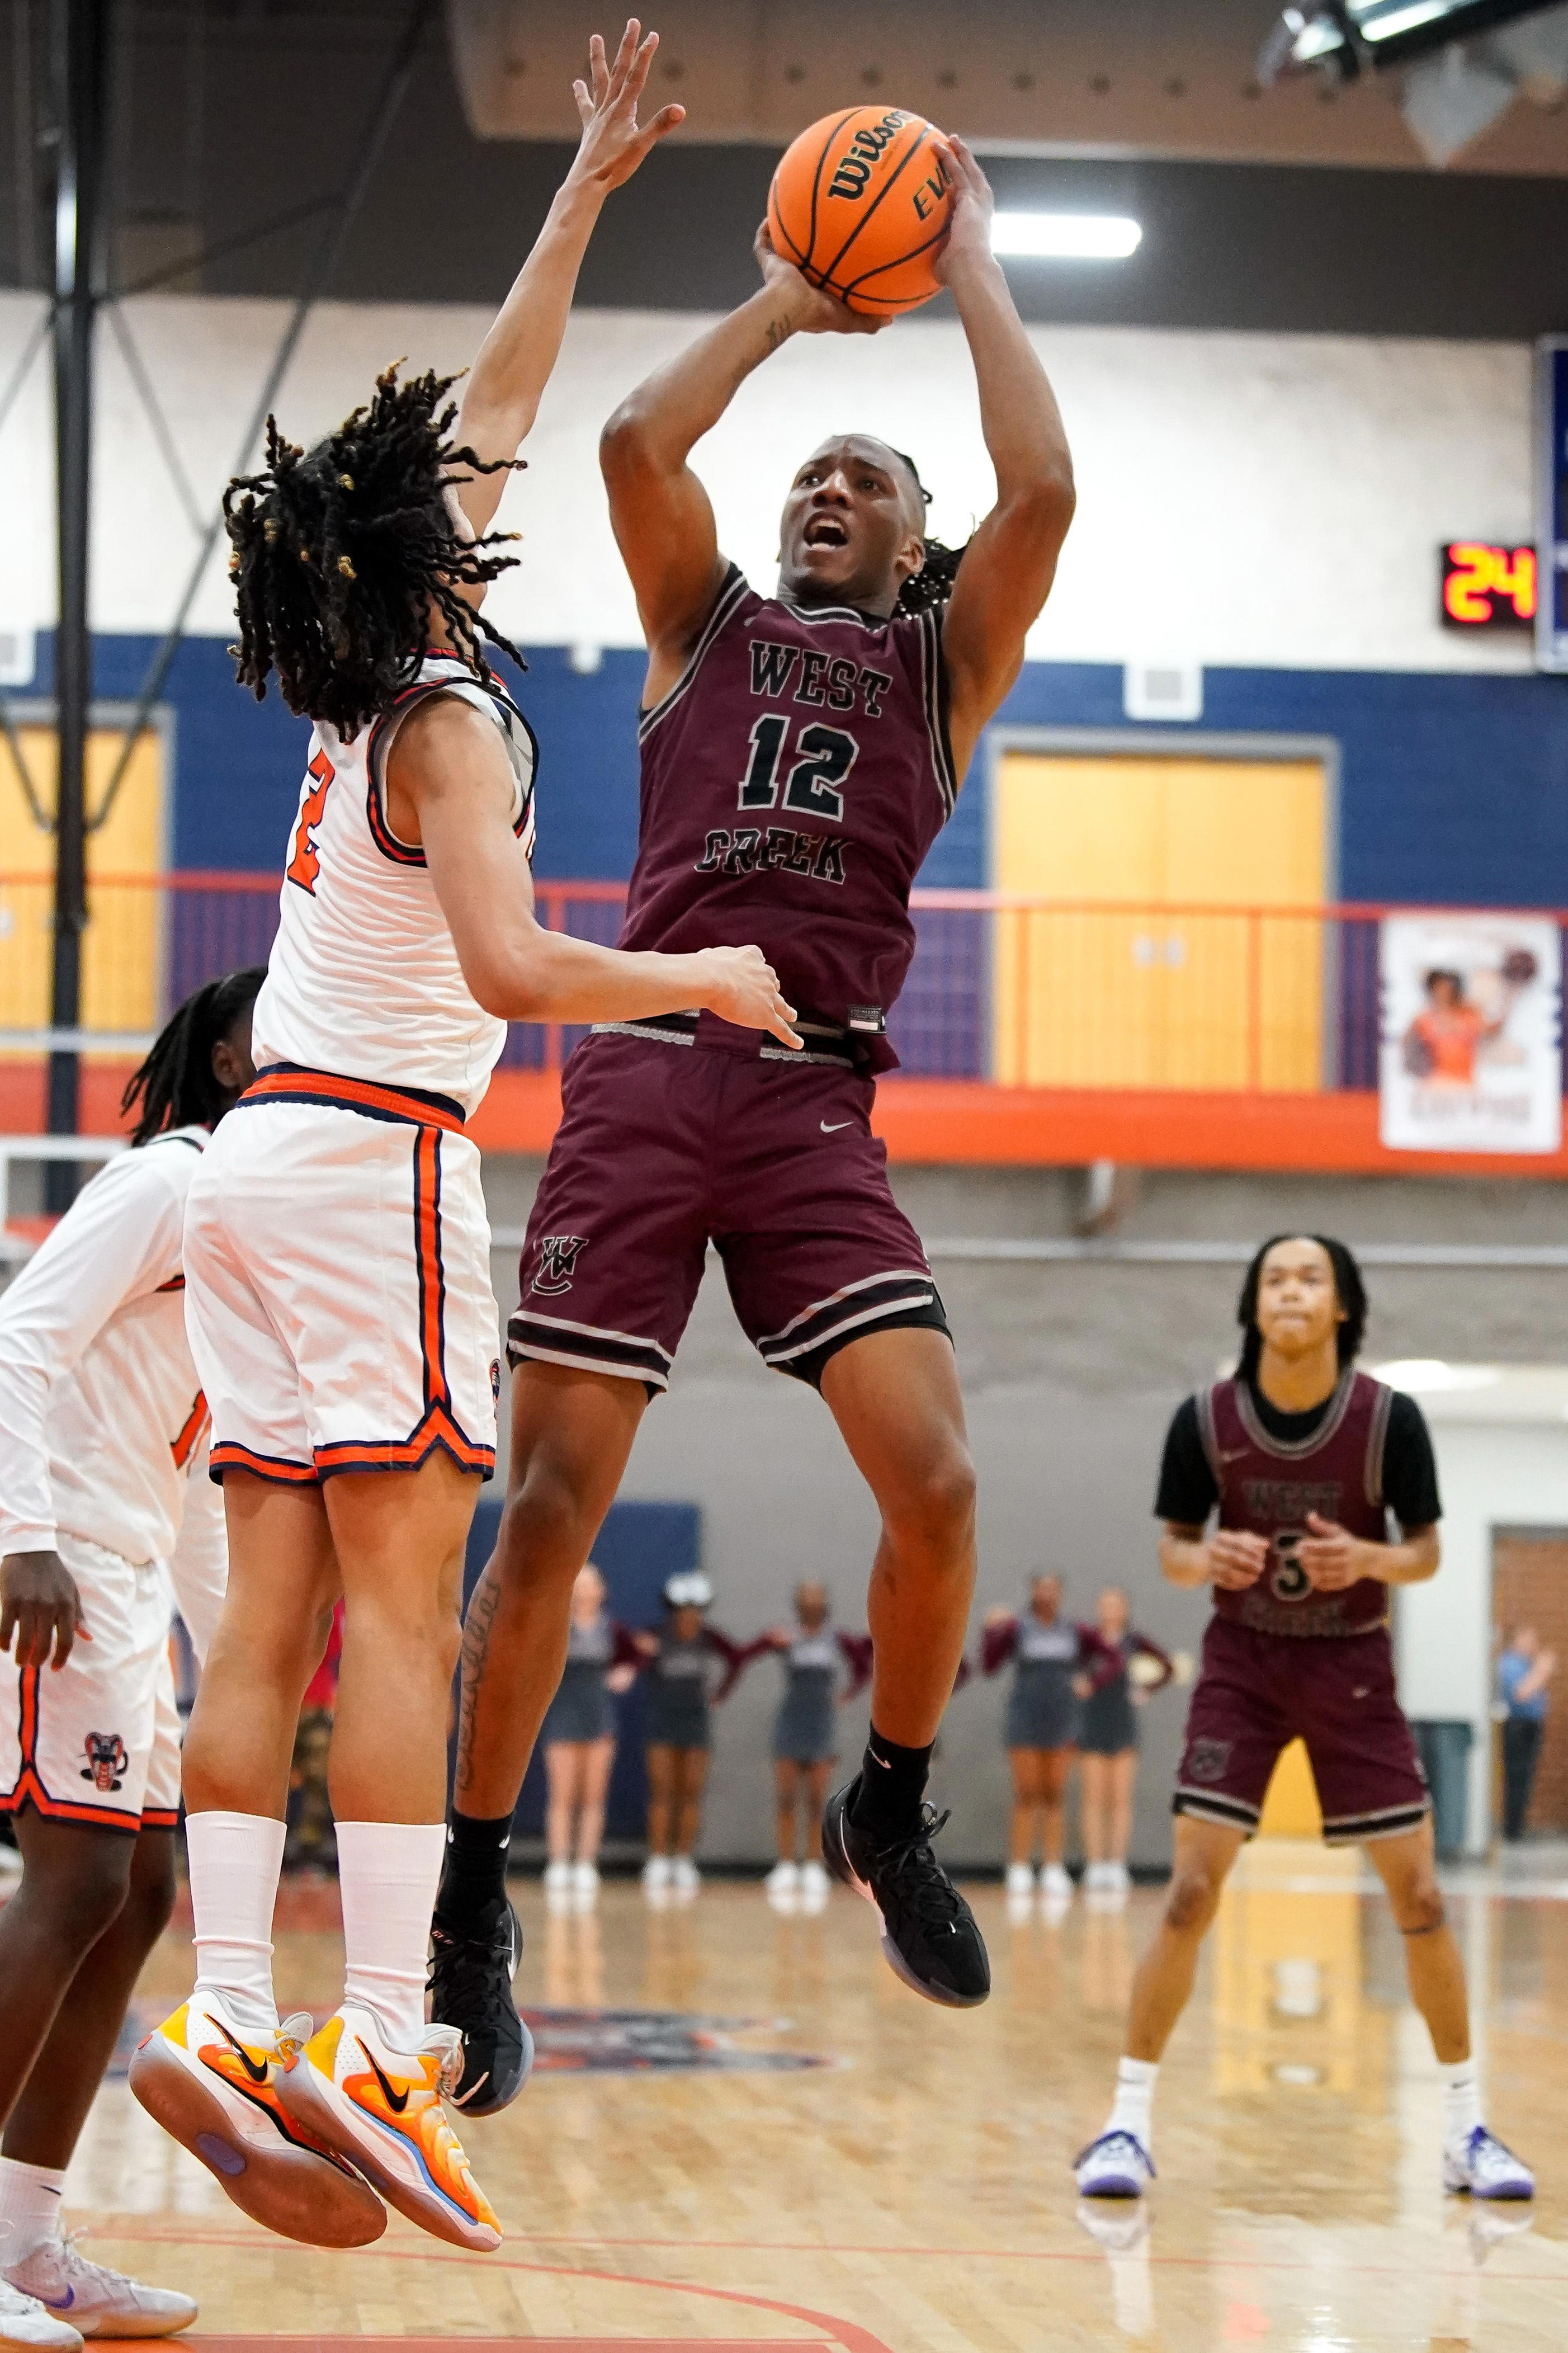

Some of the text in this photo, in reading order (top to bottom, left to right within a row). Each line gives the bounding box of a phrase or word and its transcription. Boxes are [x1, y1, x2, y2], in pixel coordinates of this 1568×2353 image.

[1445, 543, 1538, 623] 24
[748, 639, 892, 718] WEST
[737, 713, 860, 822] 12
[287, 747, 336, 898] 2
[693, 827, 854, 885] CREEK
